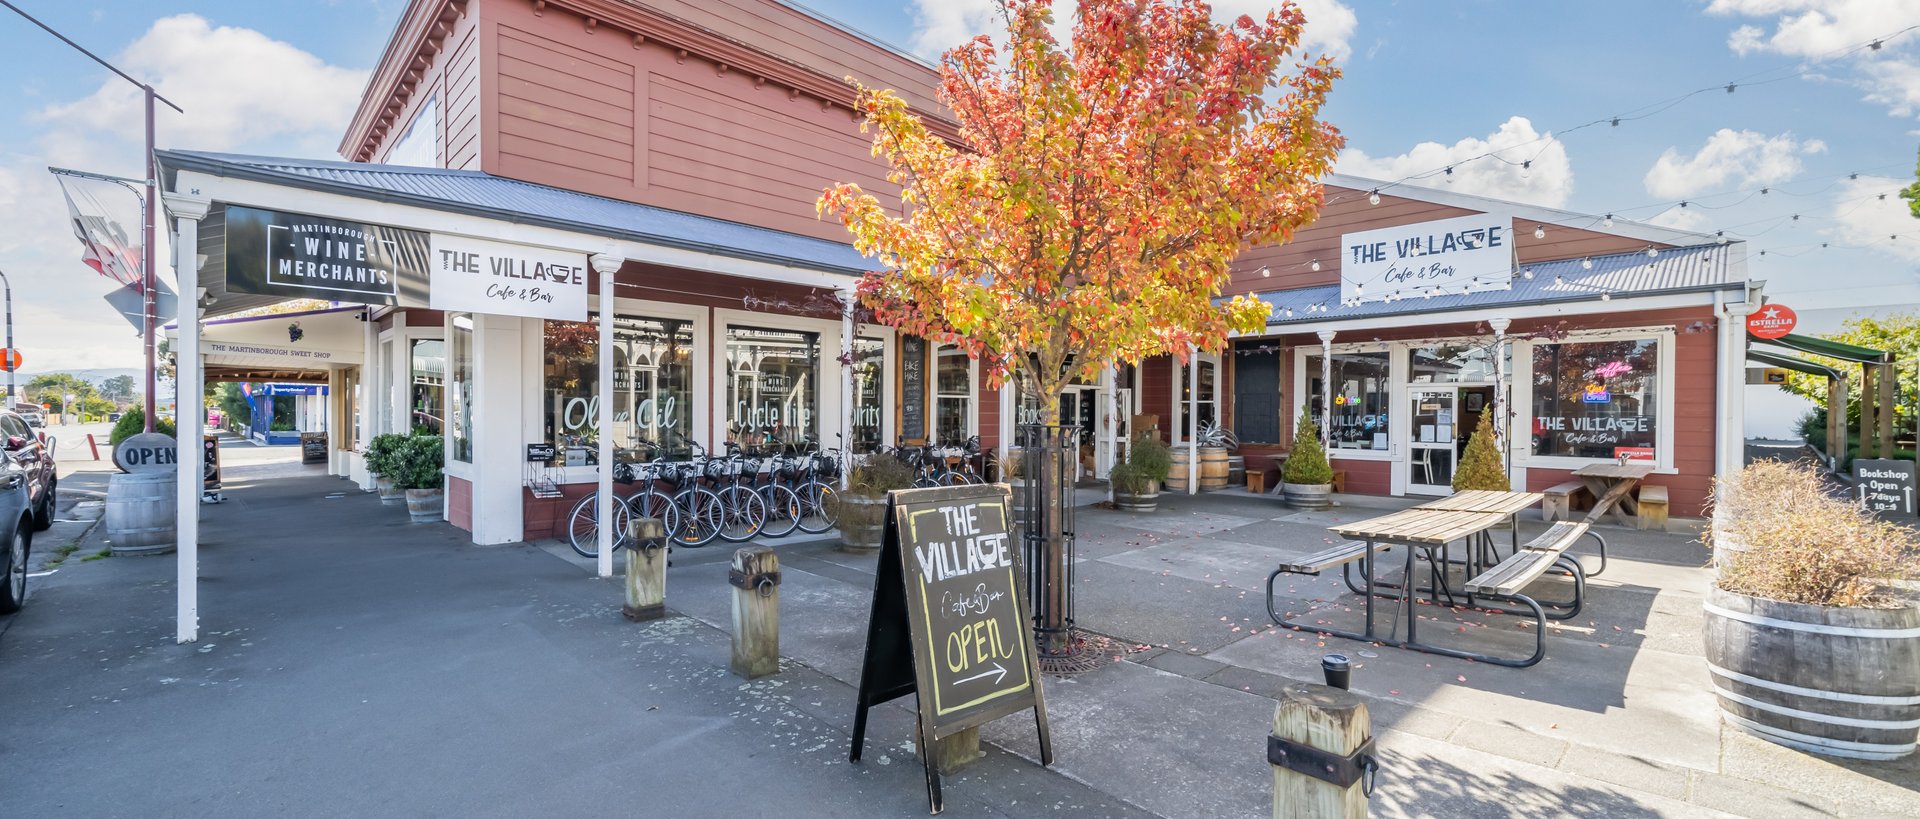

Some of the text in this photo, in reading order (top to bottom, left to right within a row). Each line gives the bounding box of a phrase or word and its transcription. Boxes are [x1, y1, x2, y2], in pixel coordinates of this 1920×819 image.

[291, 224, 376, 243] MARTINBOROUGH
[304, 236, 365, 262] WINE
[1351, 226, 1502, 264] THE VILLAGE
[279, 258, 389, 286] MERCHANTS
[439, 249, 583, 286] THE VILLAGE
[1384, 262, 1457, 284] Cafe & Bar
[486, 283, 555, 304] Cafe & Bar
[1750, 318, 1793, 327] ESTRELLA
[211, 344, 332, 359] THE MARTINBOROUGH SWEET SHOP
[738, 400, 779, 433] Cycle
[1537, 416, 1649, 432] THE VILLAGE
[1565, 432, 1587, 444] Cafe
[1596, 432, 1619, 444] Bar
[125, 447, 177, 466] OPEN
[1859, 468, 1909, 481] Bookshop
[1870, 480, 1899, 492] Open
[938, 503, 981, 536] THE
[914, 532, 1012, 584] VILLAGE
[941, 590, 975, 619] Cafe
[974, 582, 1005, 614] Bar
